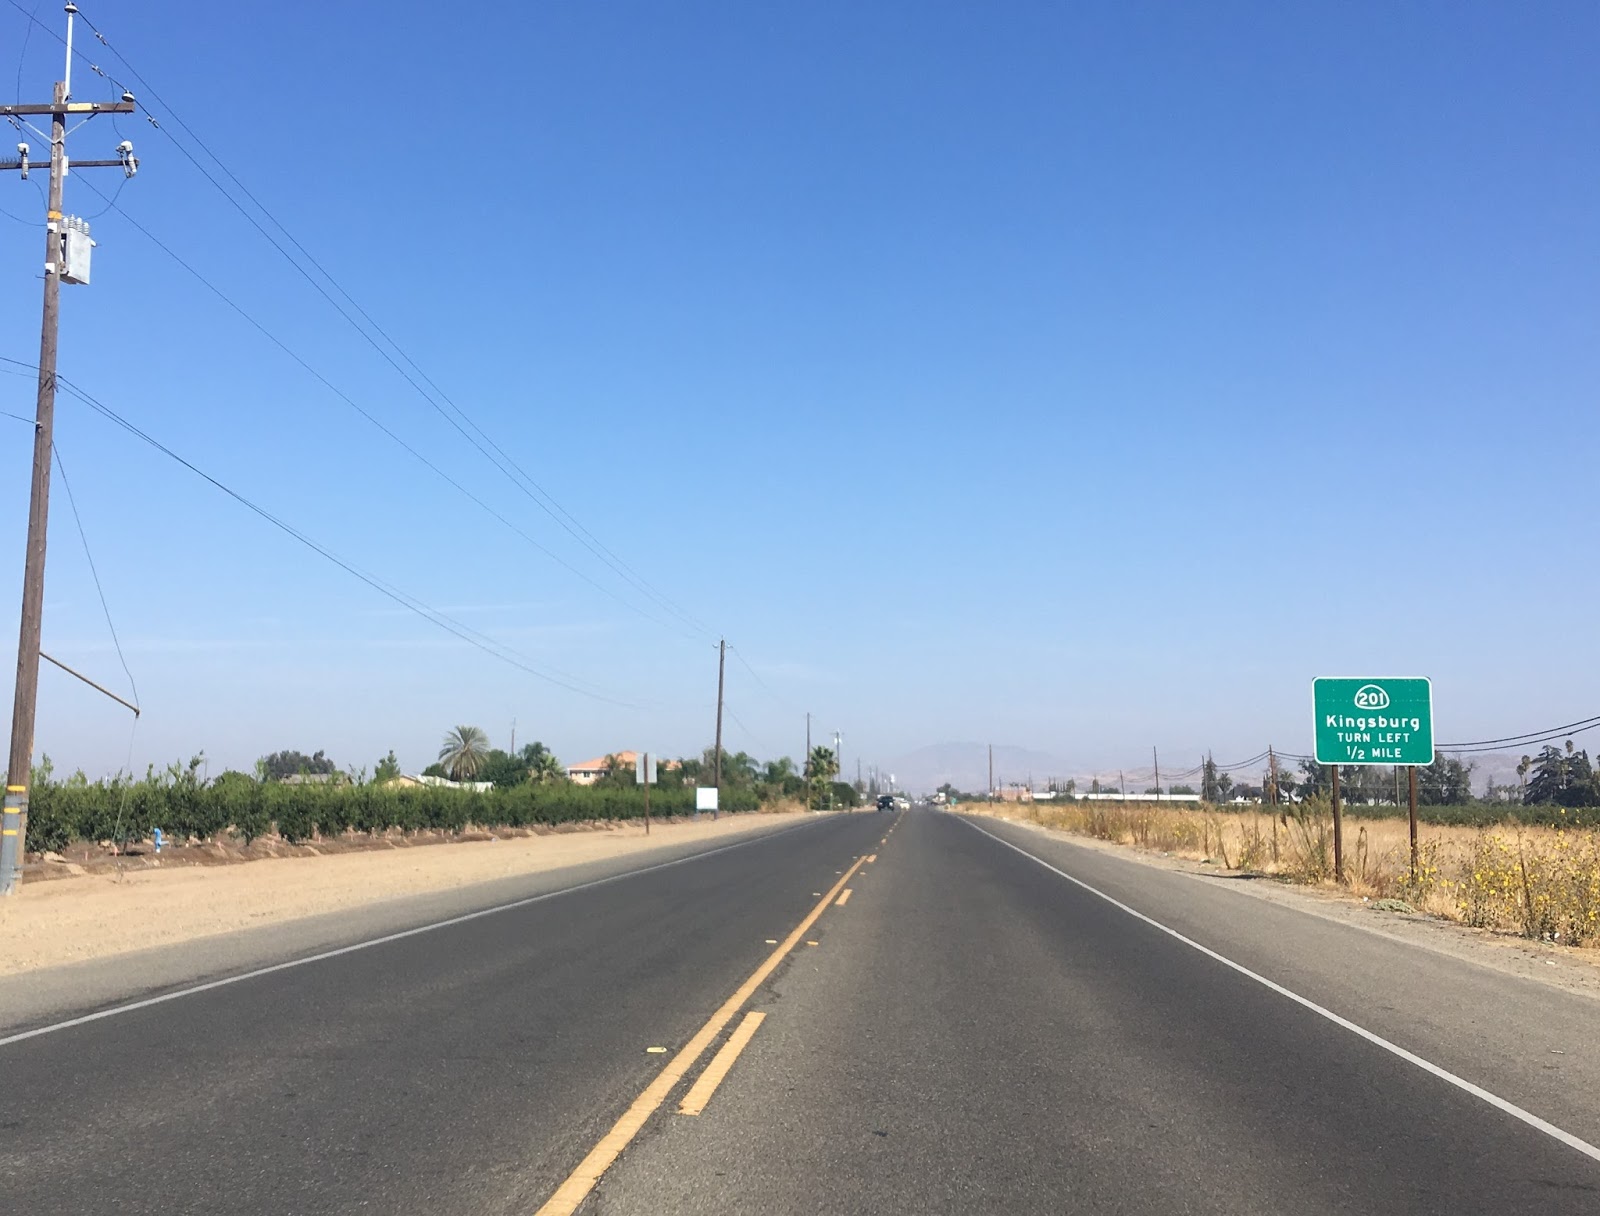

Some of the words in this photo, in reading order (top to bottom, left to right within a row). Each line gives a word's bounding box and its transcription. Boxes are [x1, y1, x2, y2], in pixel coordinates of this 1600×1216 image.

[1359, 692, 1384, 705] 201
[1326, 714, 1420, 731] Kingsburg
[1337, 733, 1370, 742] TURN
[1379, 733, 1410, 742] LEFT
[1346, 745, 1365, 759] 1/2
[1372, 748, 1402, 758] MILE
